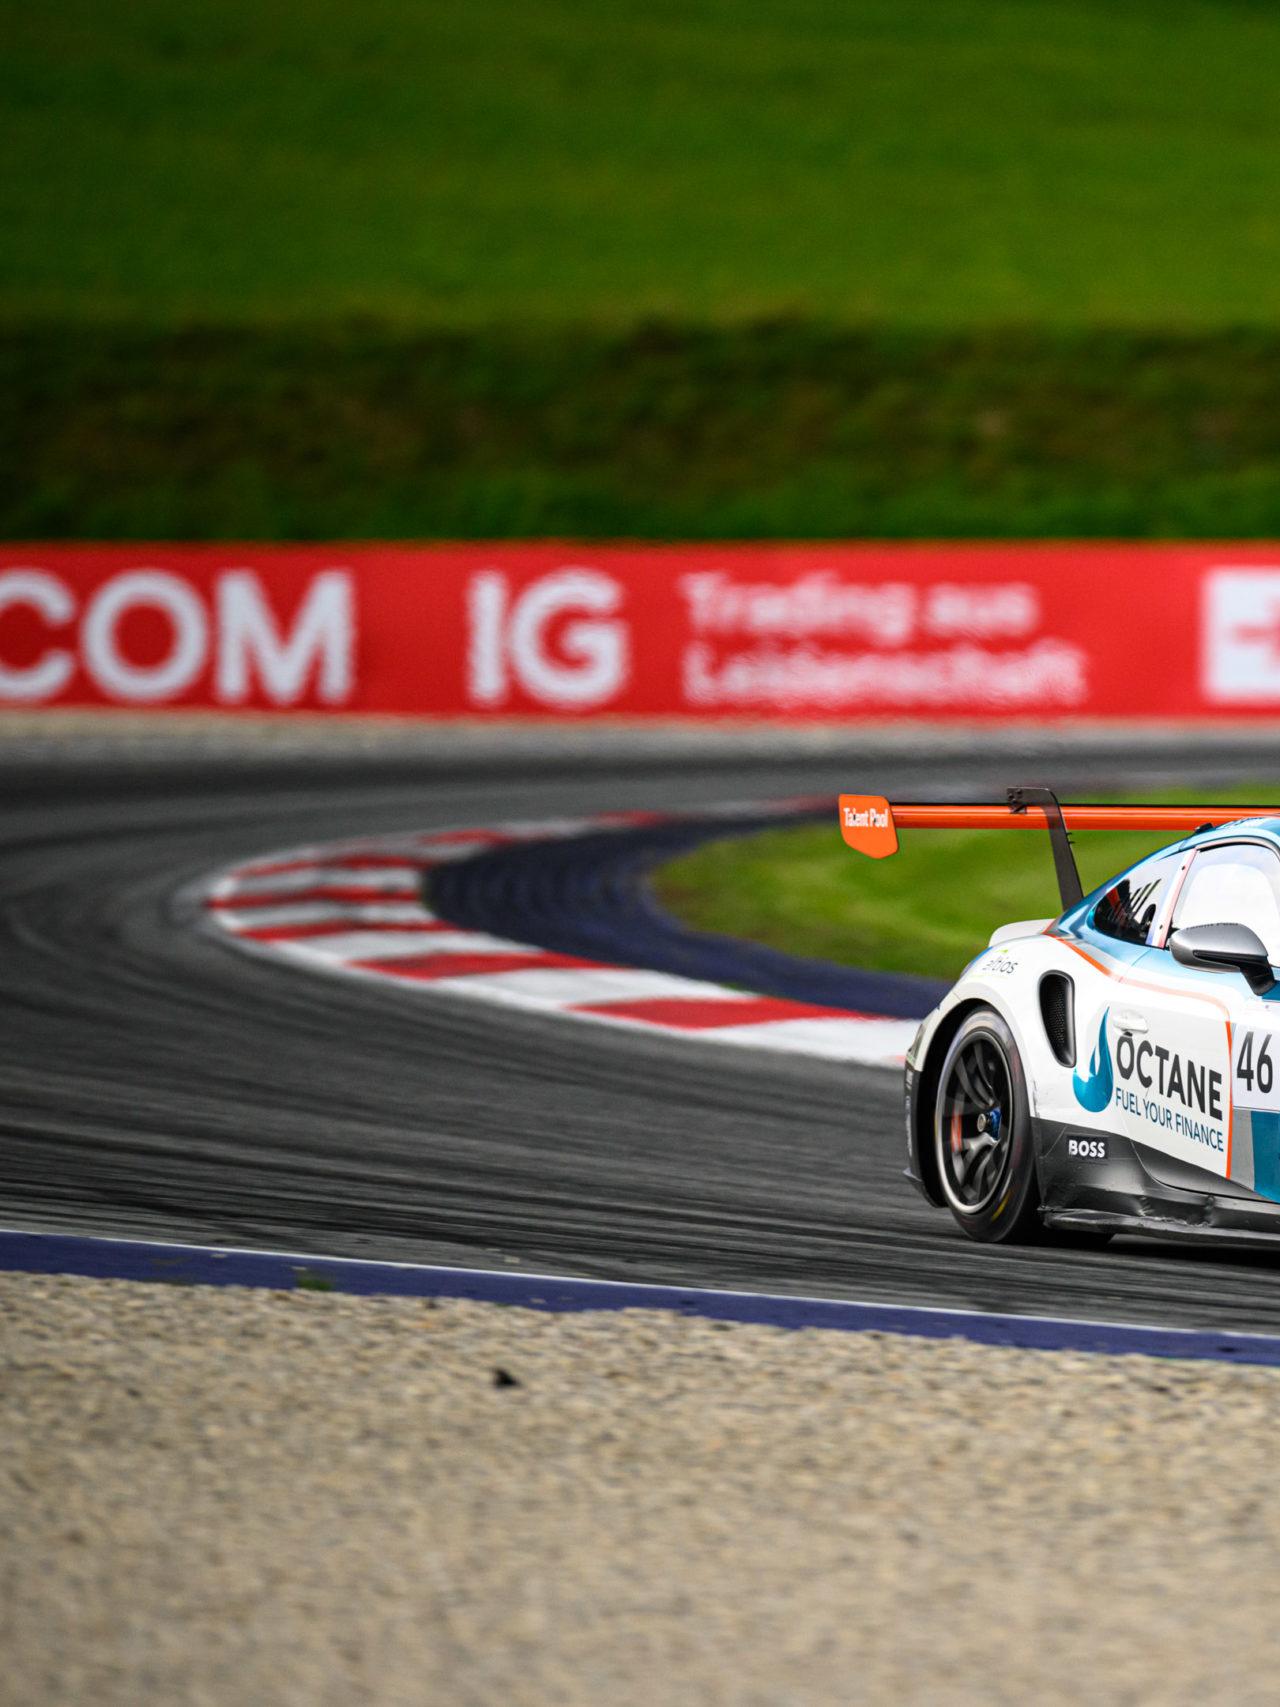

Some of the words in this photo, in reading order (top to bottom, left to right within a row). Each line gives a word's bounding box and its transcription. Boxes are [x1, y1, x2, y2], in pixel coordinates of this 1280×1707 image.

[467, 566, 630, 706] IG
[1116, 1035, 1223, 1121] OCTANE
[1236, 1031, 1273, 1094] 46
[1068, 1139, 1105, 1158] BOSS
[1115, 1087, 1142, 1116] FUEL
[1143, 1098, 1173, 1130] YOUR
[1175, 1113, 1224, 1152] FINANCE
